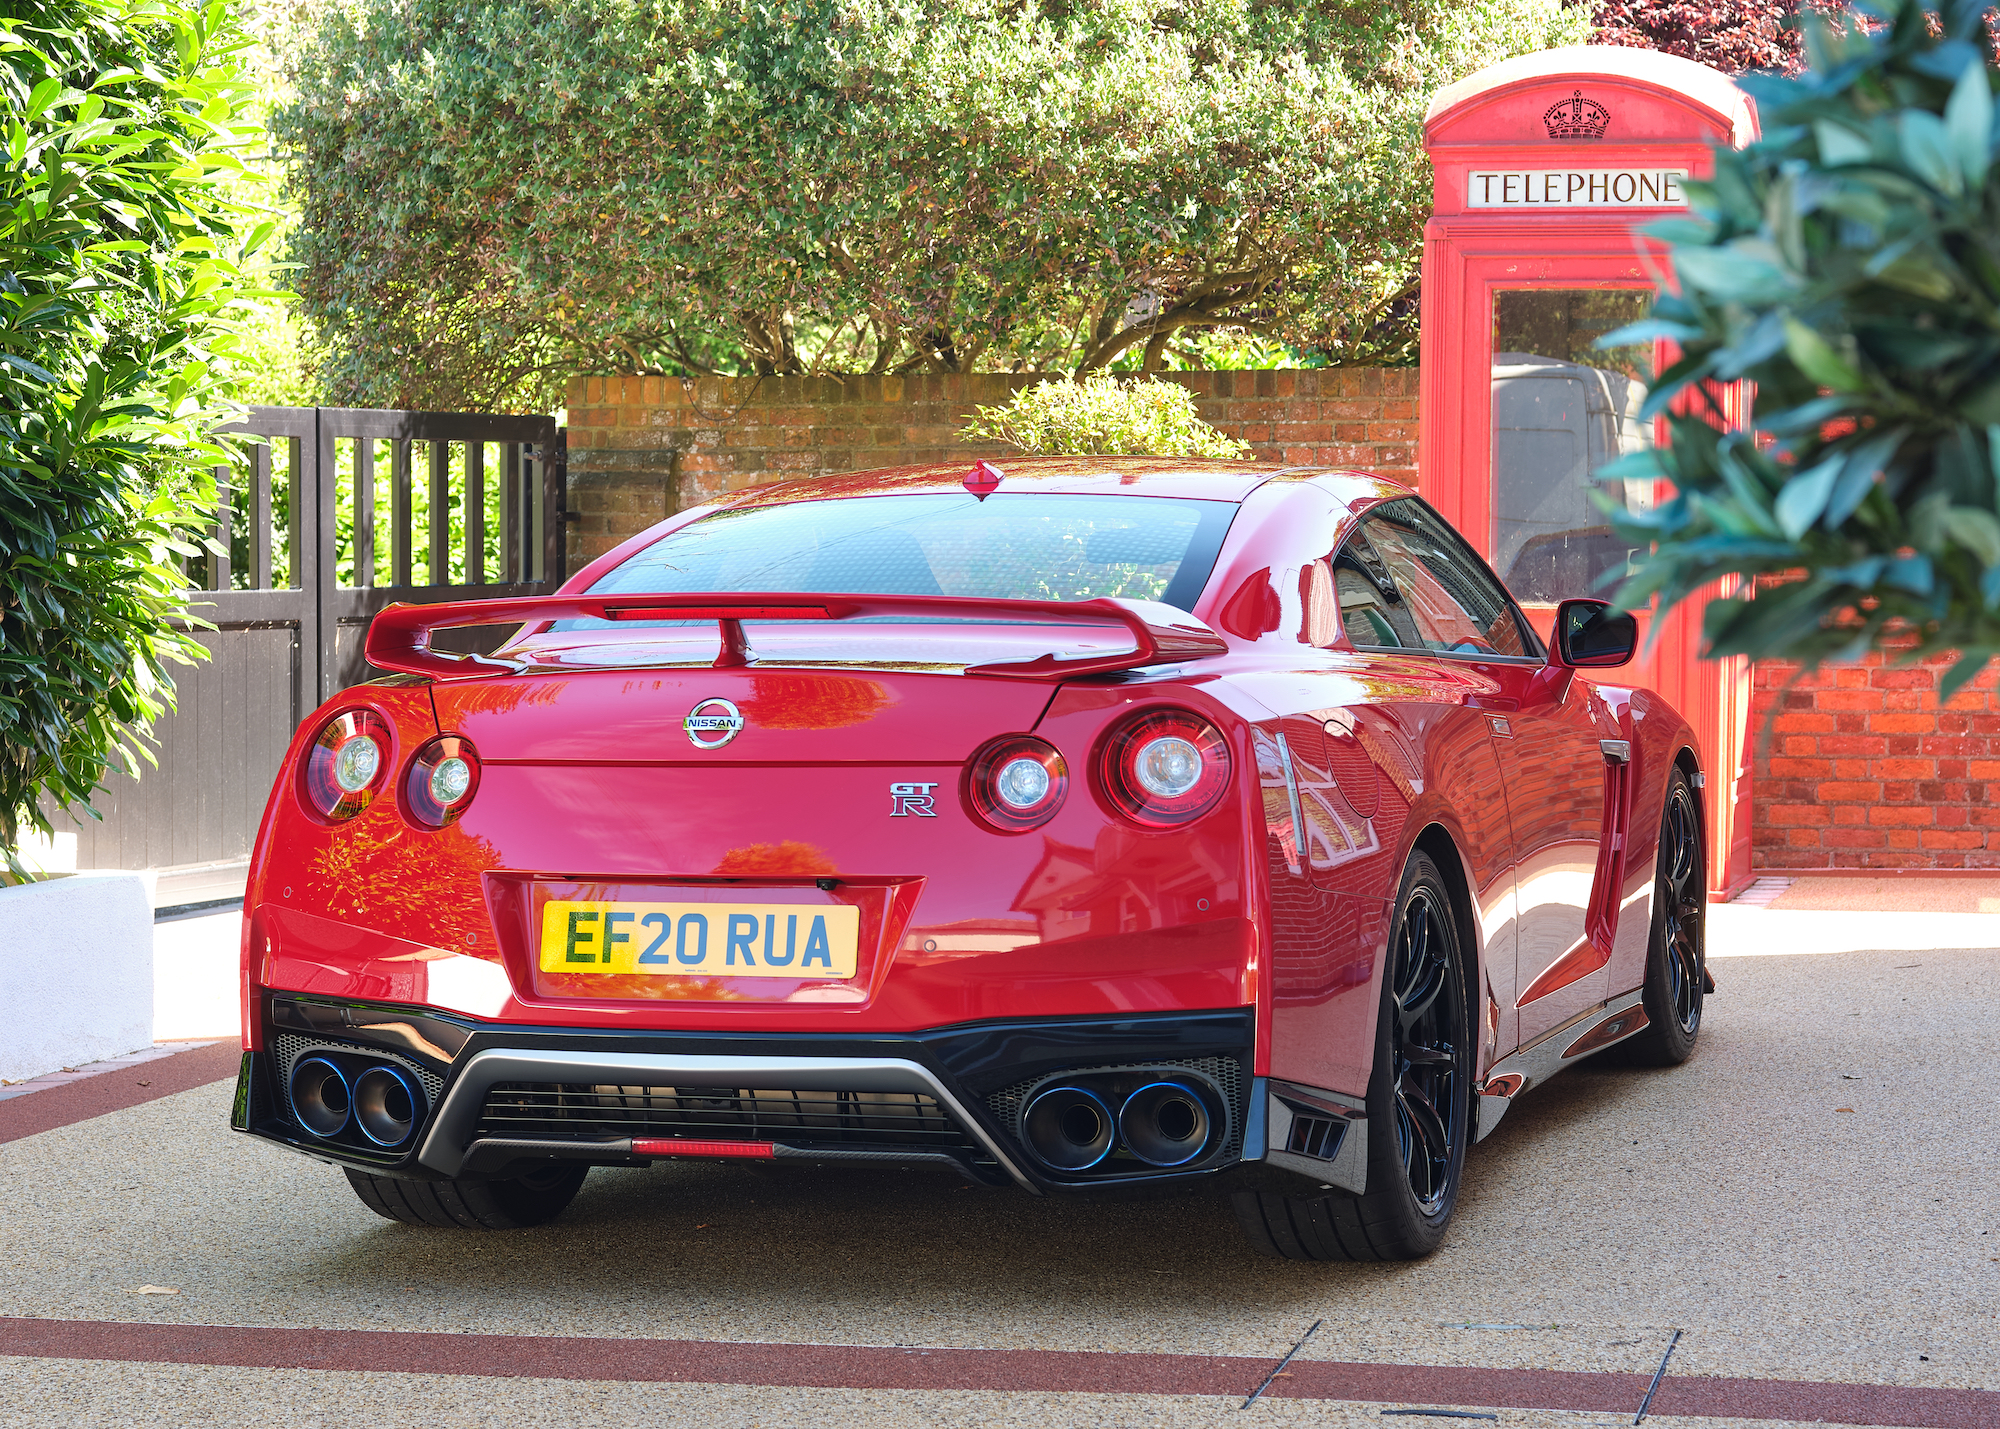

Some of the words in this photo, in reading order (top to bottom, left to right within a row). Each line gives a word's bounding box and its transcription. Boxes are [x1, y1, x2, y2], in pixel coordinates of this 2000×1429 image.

[1476, 173, 1681, 203] TELEPHONE
[688, 719, 736, 727] NISSAN
[566, 911, 708, 965] EF20
[725, 914, 832, 967] RUA
